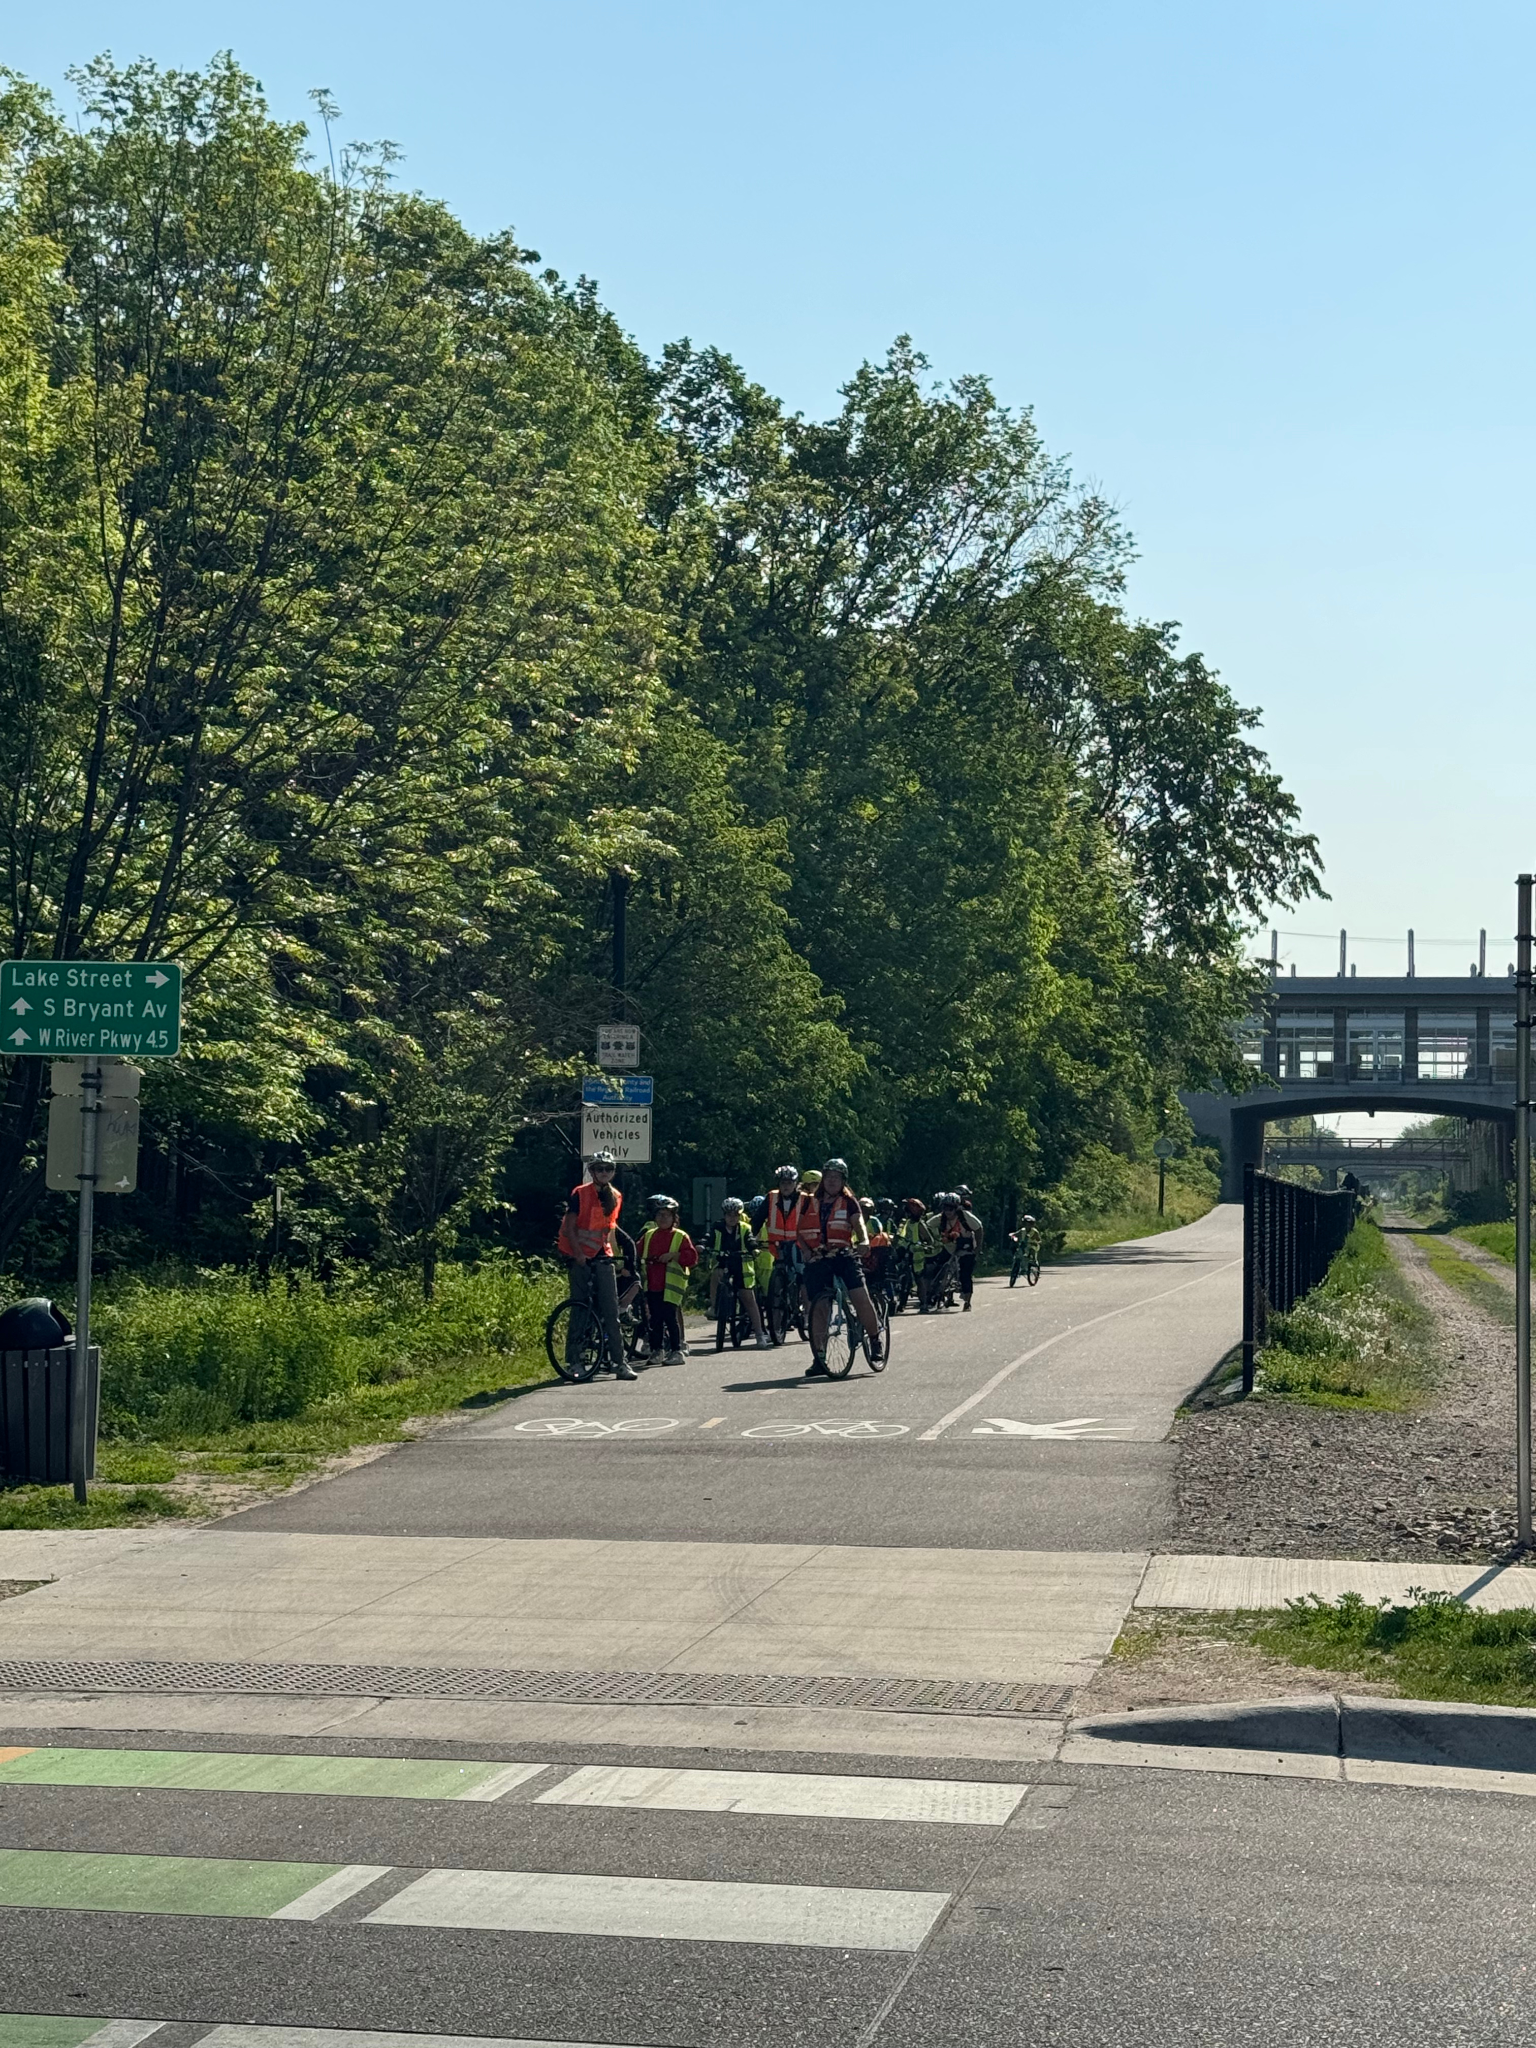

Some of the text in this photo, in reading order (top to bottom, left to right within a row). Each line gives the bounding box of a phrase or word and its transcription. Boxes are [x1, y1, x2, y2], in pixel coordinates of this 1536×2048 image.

[12, 968, 132, 988] Lake Street
[43, 999, 167, 1022] S Bryant Av
[39, 1028, 51, 1047] W
[55, 1028, 95, 1048] River
[100, 1029, 142, 1052] Pkwy
[586, 1112, 648, 1124] Authorized
[593, 1128, 640, 1140] Vehicles
[603, 1145, 629, 1158] Only
